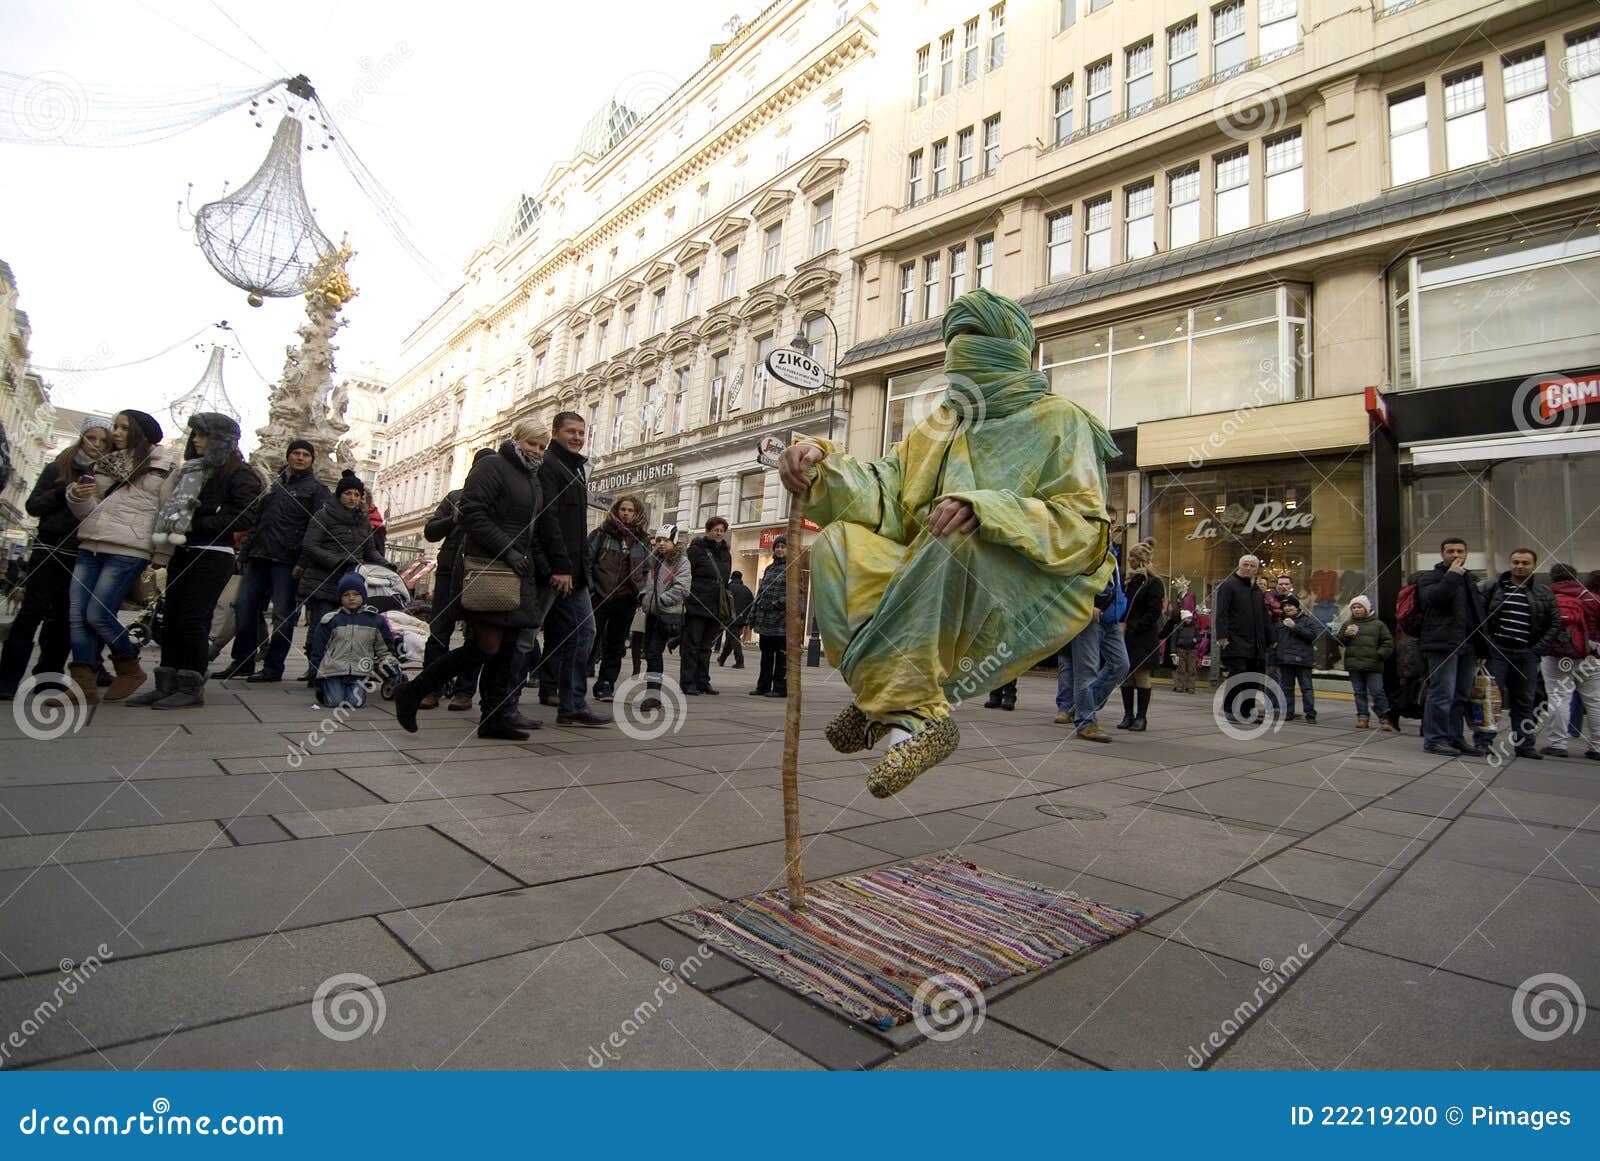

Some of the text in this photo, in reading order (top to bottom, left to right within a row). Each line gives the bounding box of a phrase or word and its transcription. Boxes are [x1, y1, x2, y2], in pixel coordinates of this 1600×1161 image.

[777, 353, 820, 377] ZIKOS
[1546, 380, 1600, 409] CAM
[600, 473, 632, 491] RUDOLF
[636, 463, 673, 481] HÜBNER
[1185, 501, 1315, 541] La Rose
